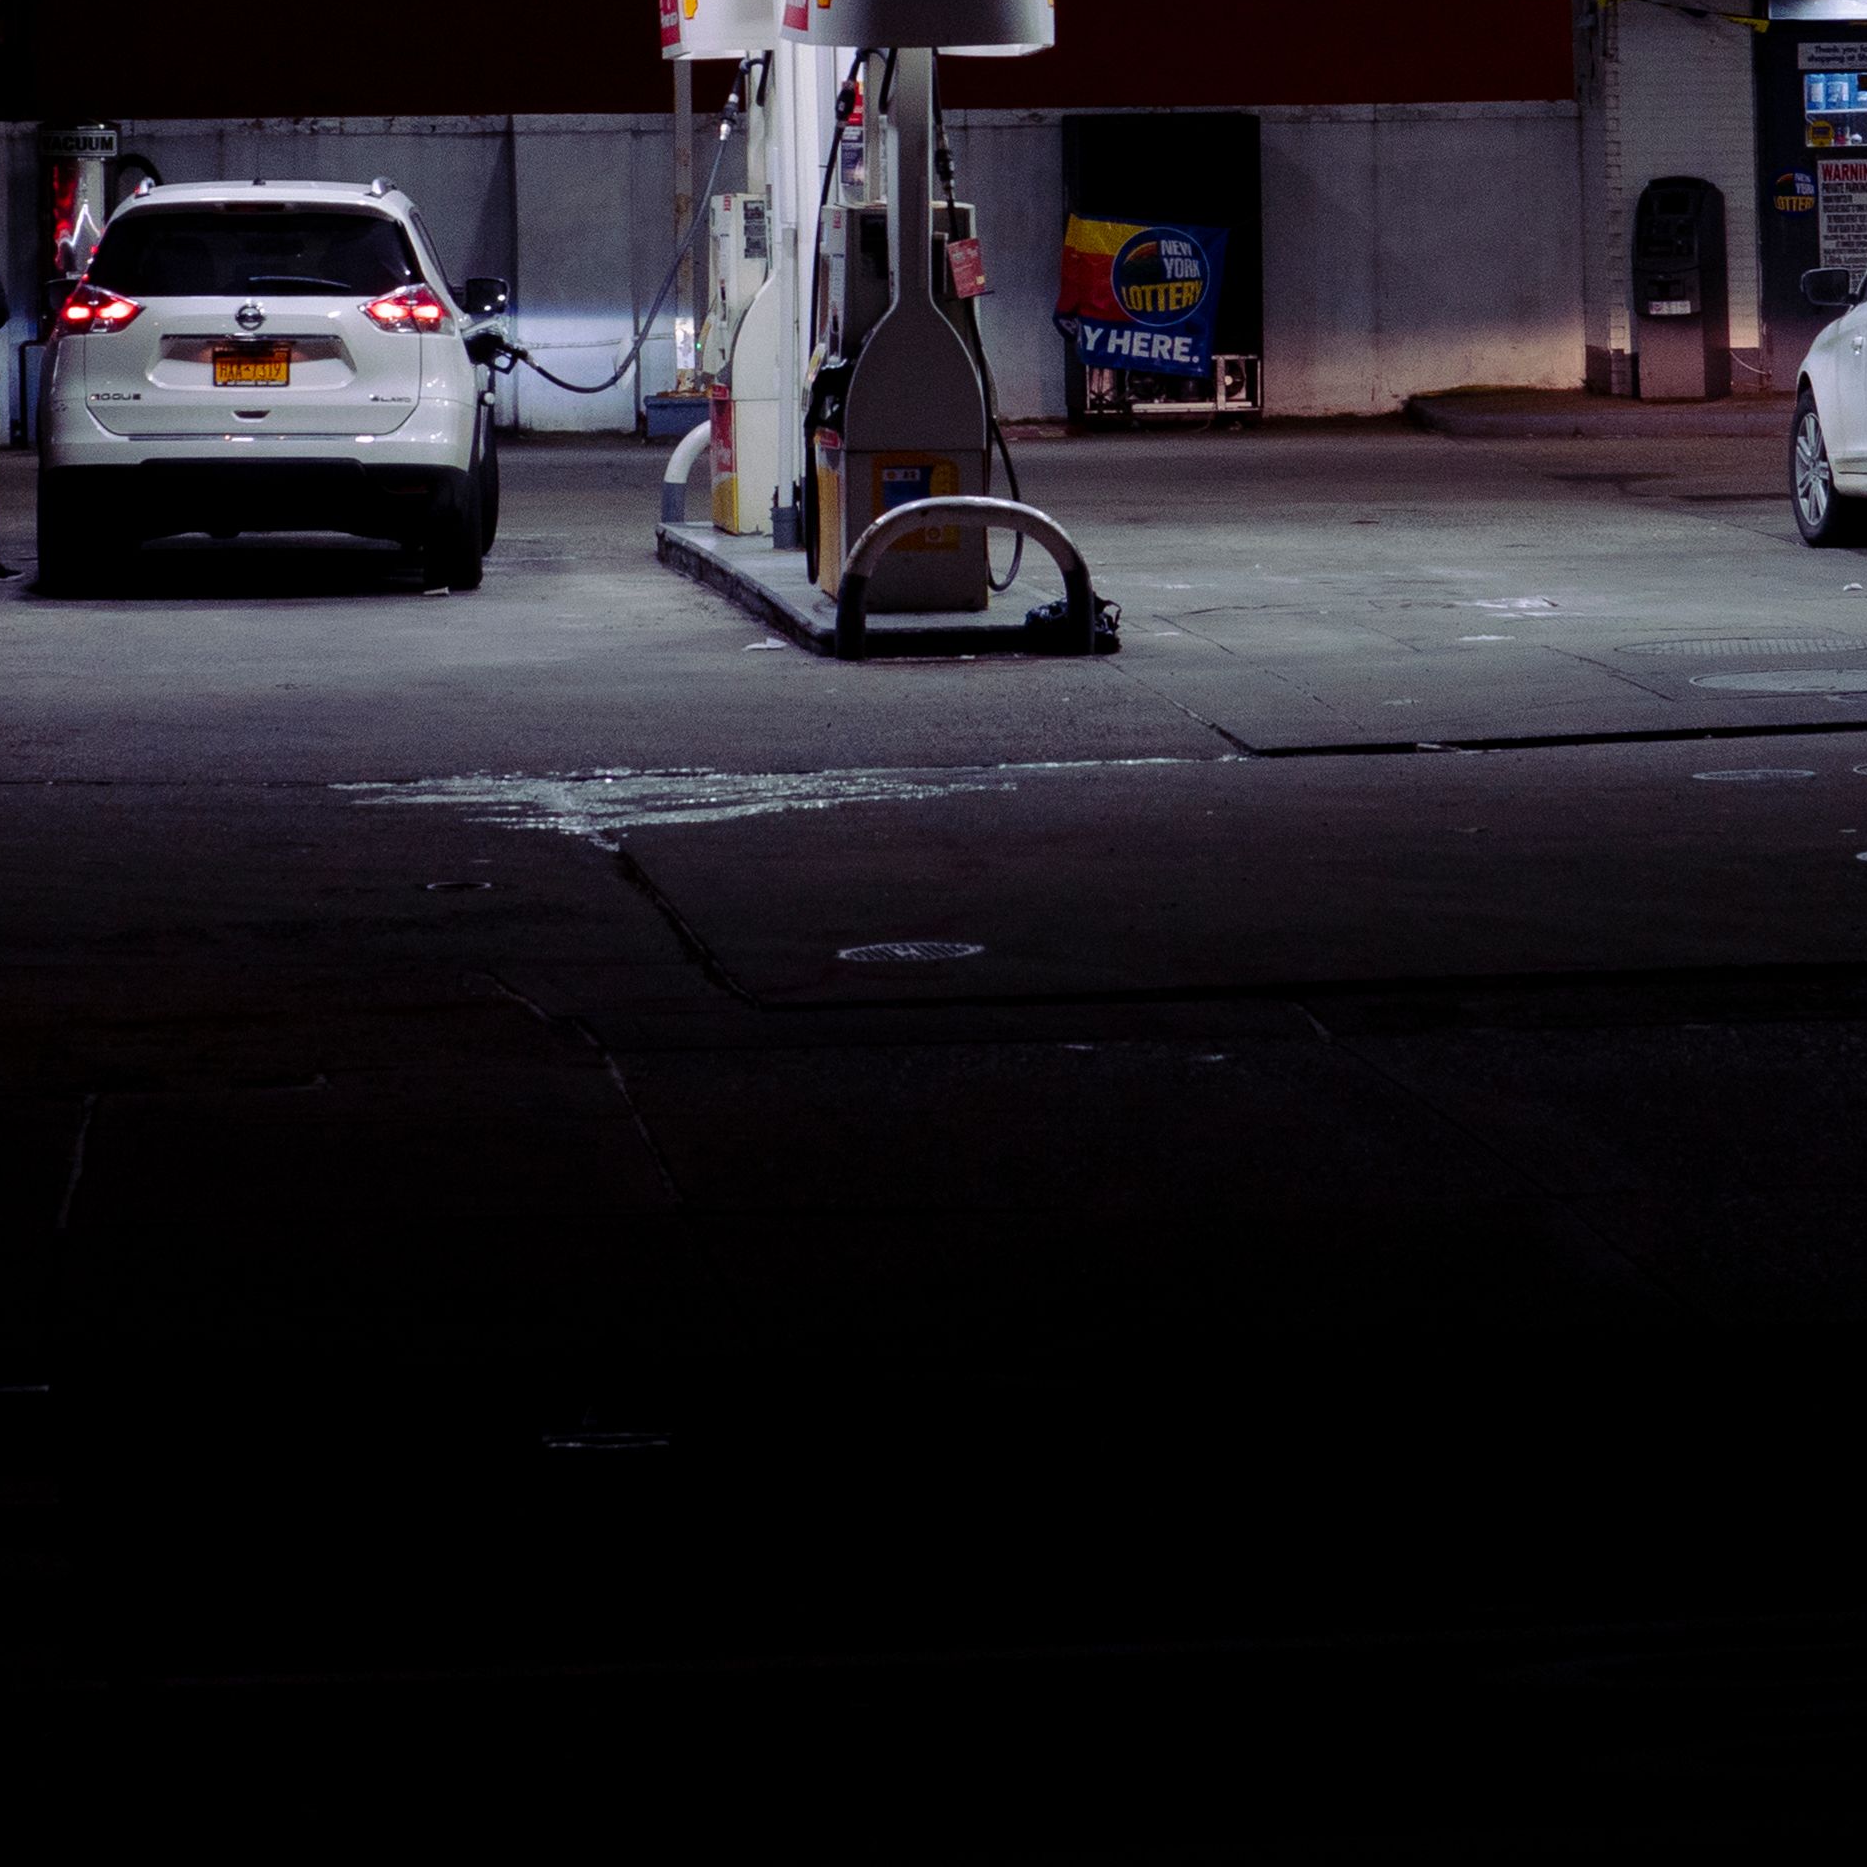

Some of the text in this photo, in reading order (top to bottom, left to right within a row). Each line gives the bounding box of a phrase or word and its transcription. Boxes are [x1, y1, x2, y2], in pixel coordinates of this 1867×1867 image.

[1807, 54, 1844, 63] shopping
[1814, 45, 1839, 54] Thank
[1842, 47, 1858, 55] you
[43, 136, 113, 151] VACUUM
[1822, 182, 1844, 193] PRIVATE
[1773, 195, 1815, 212] LOTTERY
[1160, 239, 1192, 257] NEW
[1163, 258, 1200, 279] YORK
[1121, 280, 1204, 312] LOTTERY
[1107, 329, 1200, 363] HERE.
